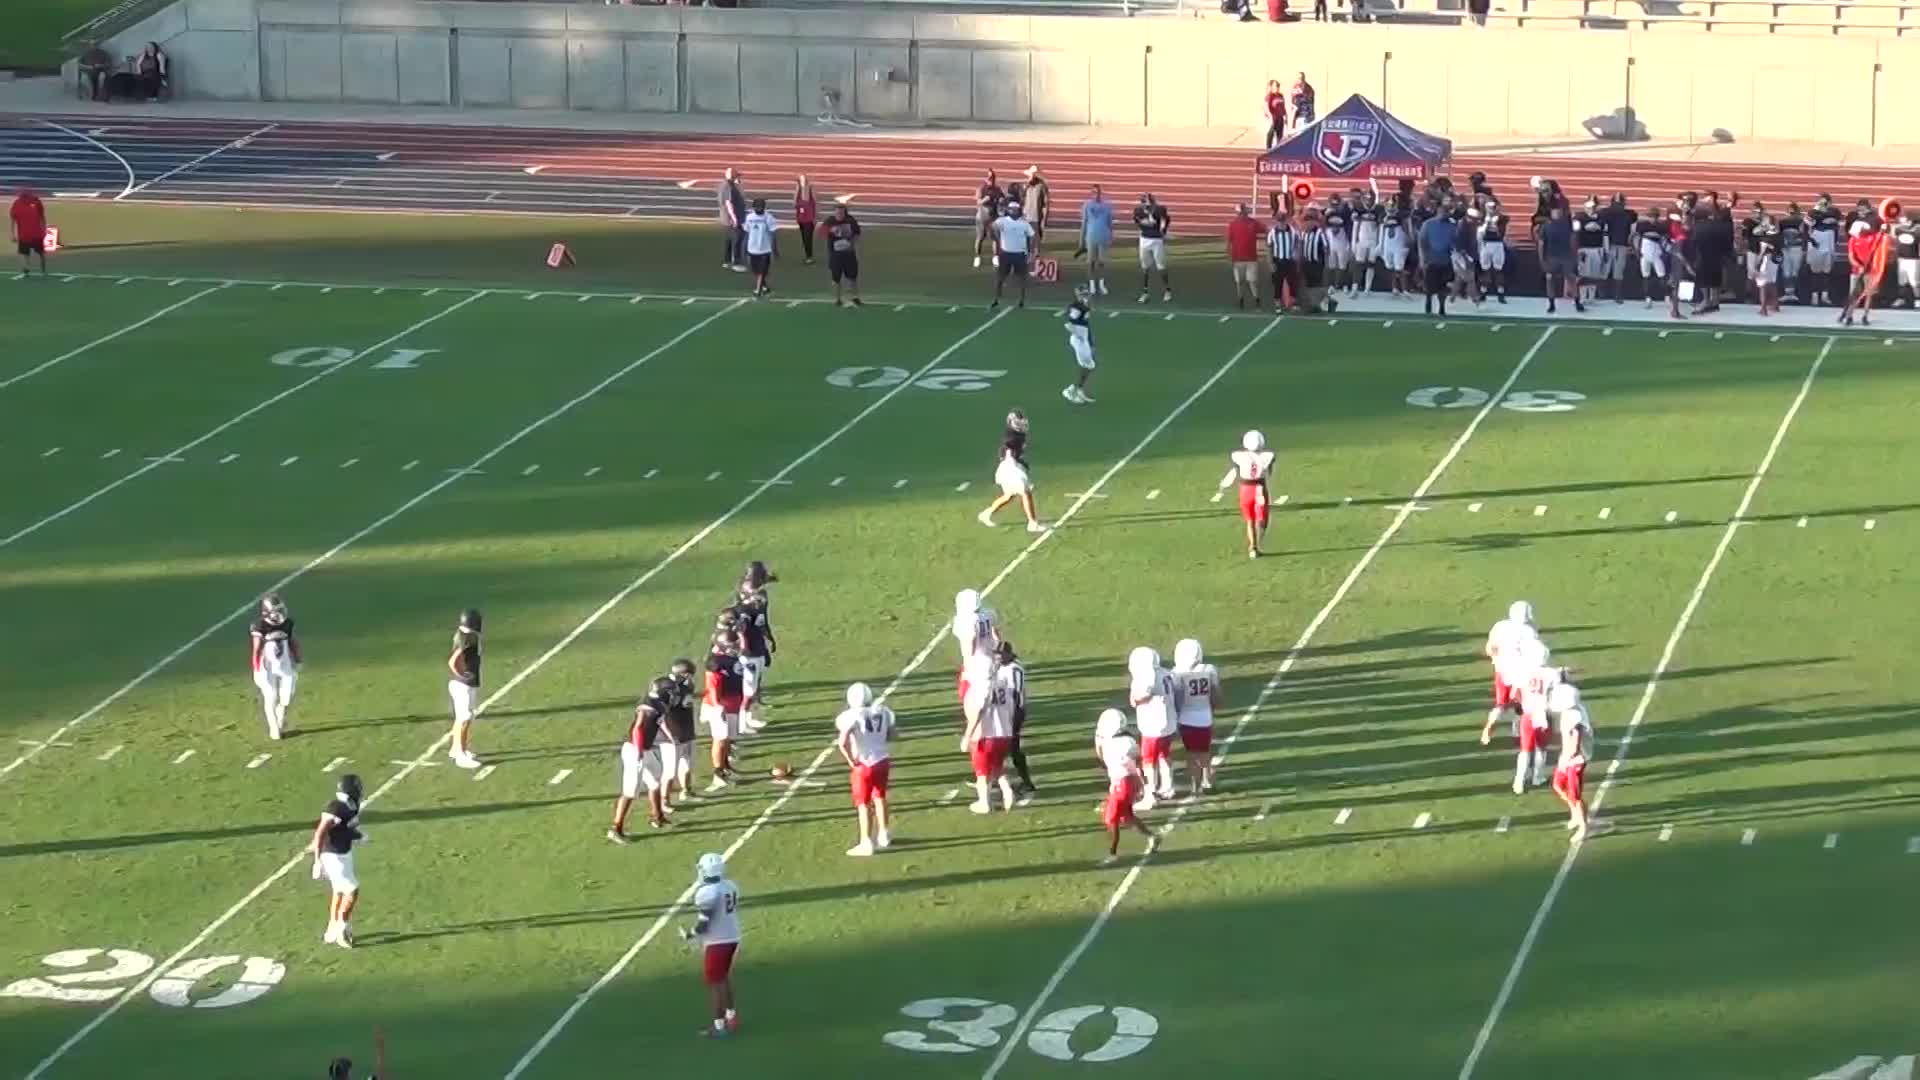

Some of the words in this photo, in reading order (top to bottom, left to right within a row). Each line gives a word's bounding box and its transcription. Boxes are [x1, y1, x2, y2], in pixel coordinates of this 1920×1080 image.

[1322, 134, 1370, 163] JG
[1037, 261, 1056, 280] 20
[1188, 677, 1209, 697] 32
[0, 947, 287, 1008] 20
[882, 997, 1159, 1061] 30
